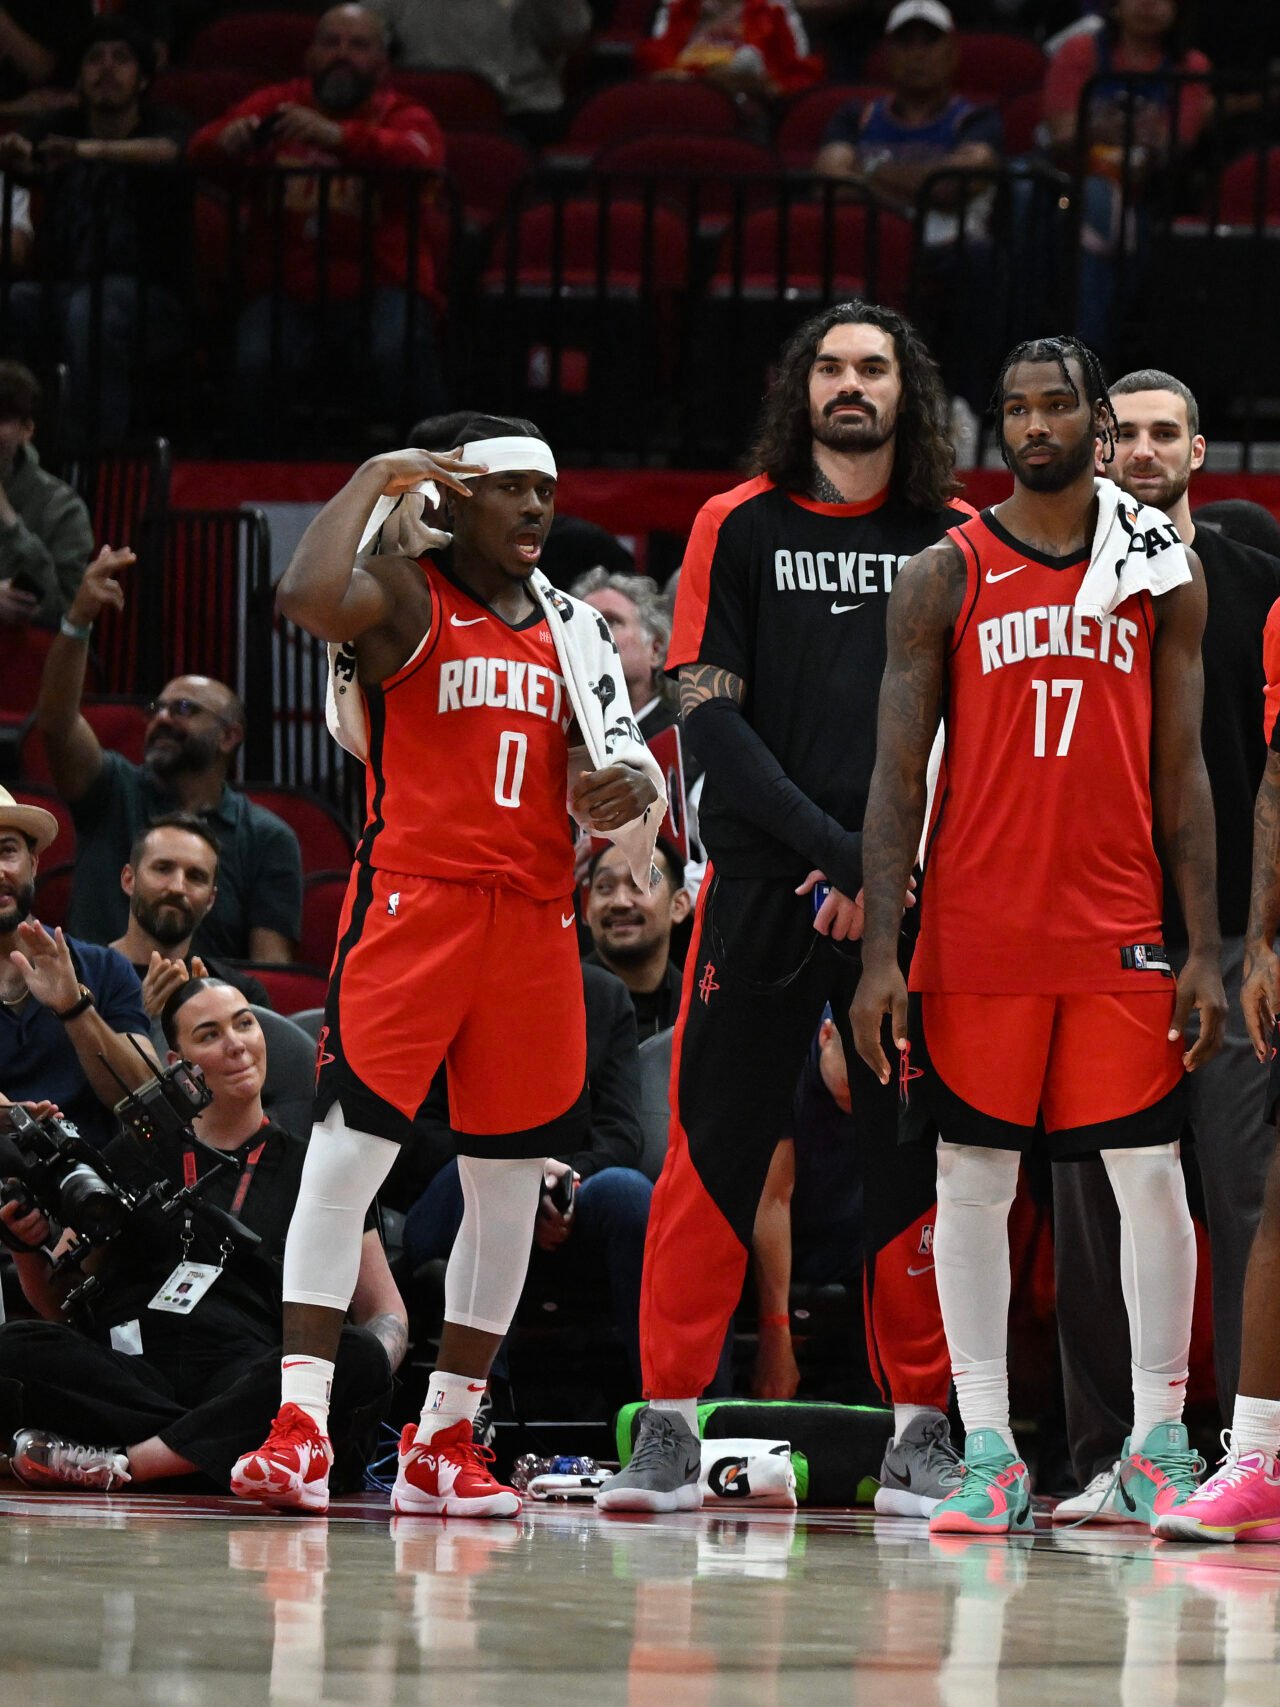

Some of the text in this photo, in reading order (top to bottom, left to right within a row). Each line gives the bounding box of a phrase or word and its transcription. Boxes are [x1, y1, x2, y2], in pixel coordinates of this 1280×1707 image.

[977, 605, 1138, 676] ROCKETS
[1031, 679, 1083, 757] 17
[494, 730, 528, 808] 0
